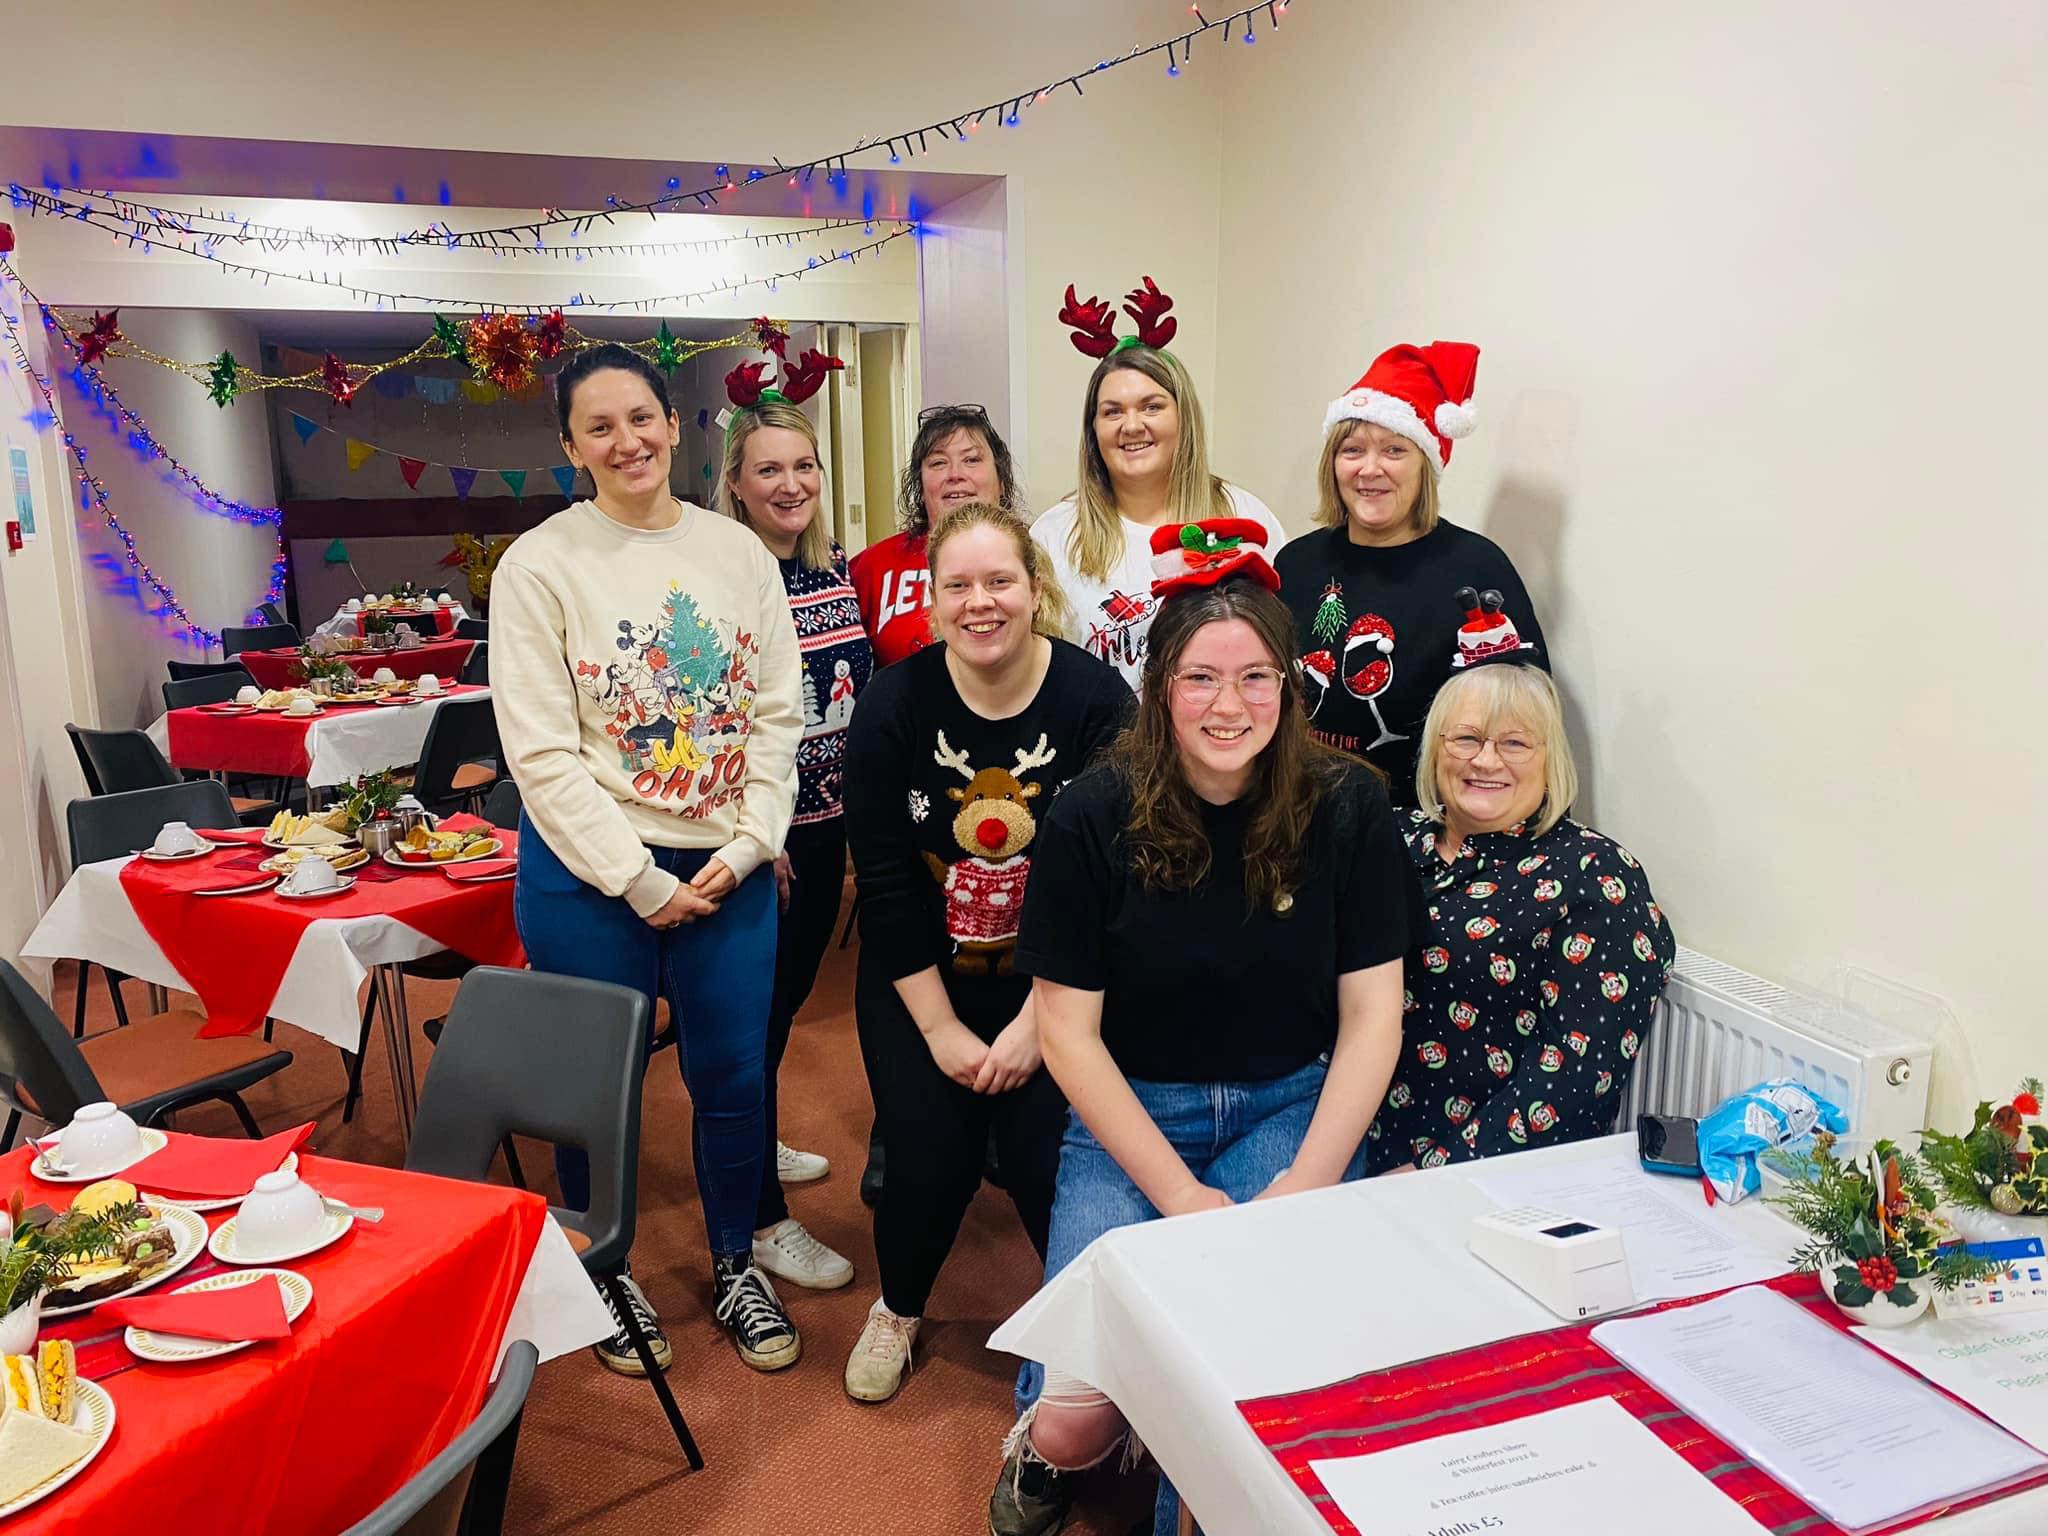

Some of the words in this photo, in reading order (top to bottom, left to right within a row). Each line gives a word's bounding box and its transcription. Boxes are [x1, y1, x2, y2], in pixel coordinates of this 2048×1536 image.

[632, 765, 695, 800] OH
[698, 750, 745, 796] JO
[1467, 1449, 1504, 1462] Crofters
[1502, 1442, 1528, 1453] Show
[1460, 1459, 1506, 1475] Winterfest
[1440, 1496, 1457, 1506] Tea
[1459, 1488, 1486, 1501] coffee
[1512, 1470, 1563, 1487] sandwiches
[1565, 1463, 1585, 1475] cake
[1480, 1516, 1504, 1528] £5
